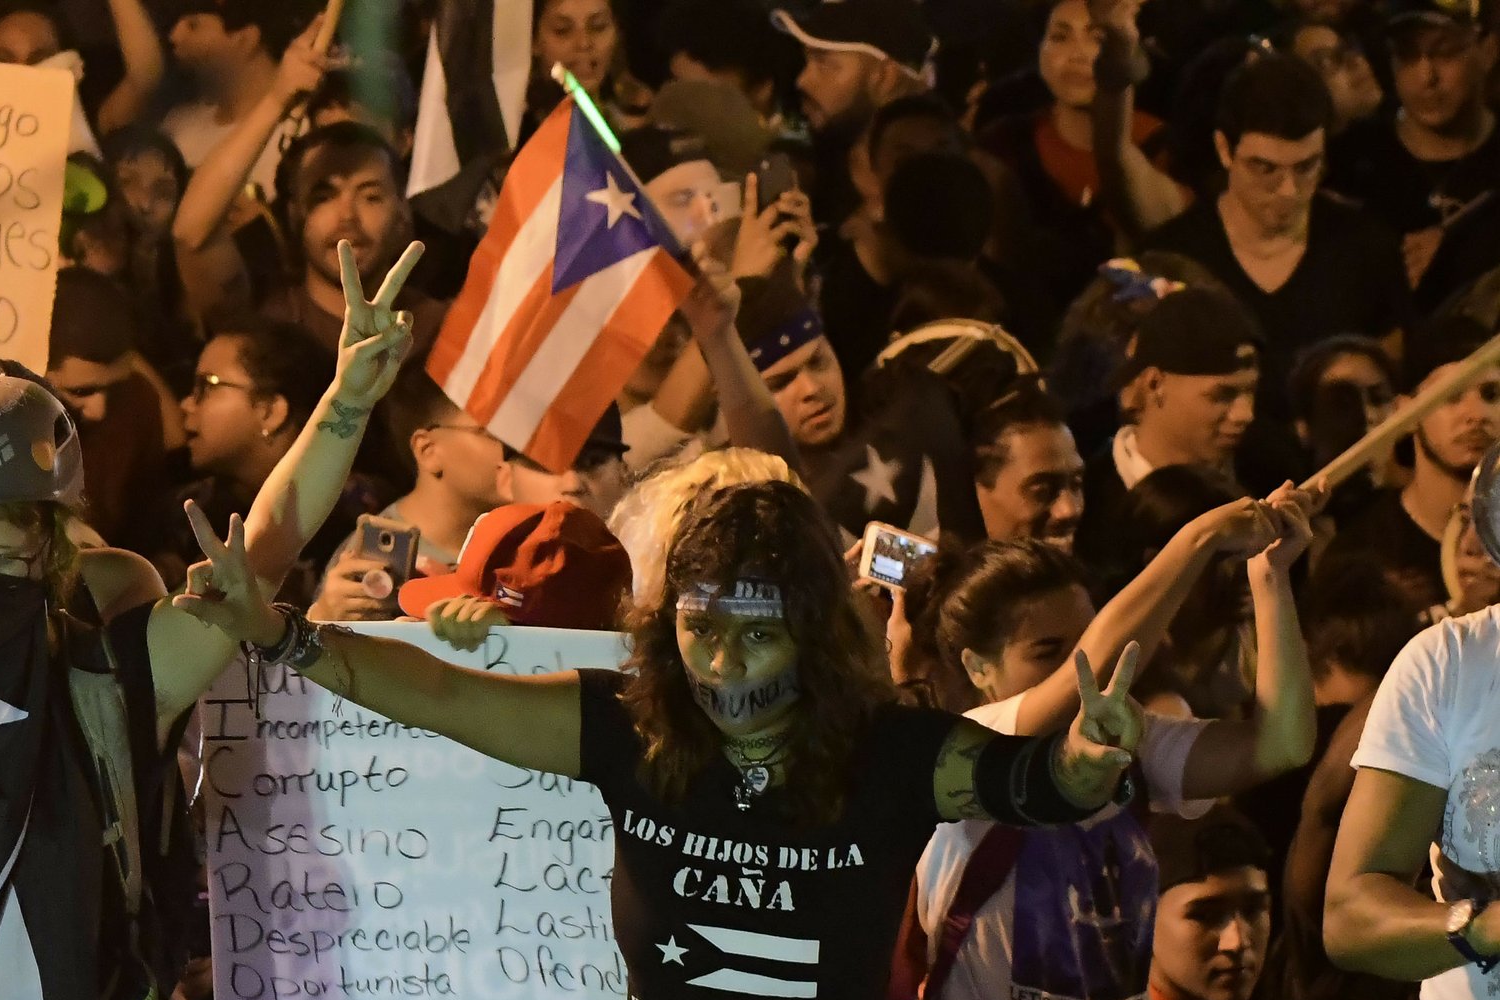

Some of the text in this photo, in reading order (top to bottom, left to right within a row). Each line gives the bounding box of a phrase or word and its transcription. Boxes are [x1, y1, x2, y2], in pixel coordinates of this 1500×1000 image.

[207, 746, 409, 808] Corrupto
[216, 806, 429, 859] Asesino
[623, 809, 864, 871] LOS HIJOS DE LA
[673, 867, 795, 911] CAÑA
[215, 913, 471, 964] Despreciable
